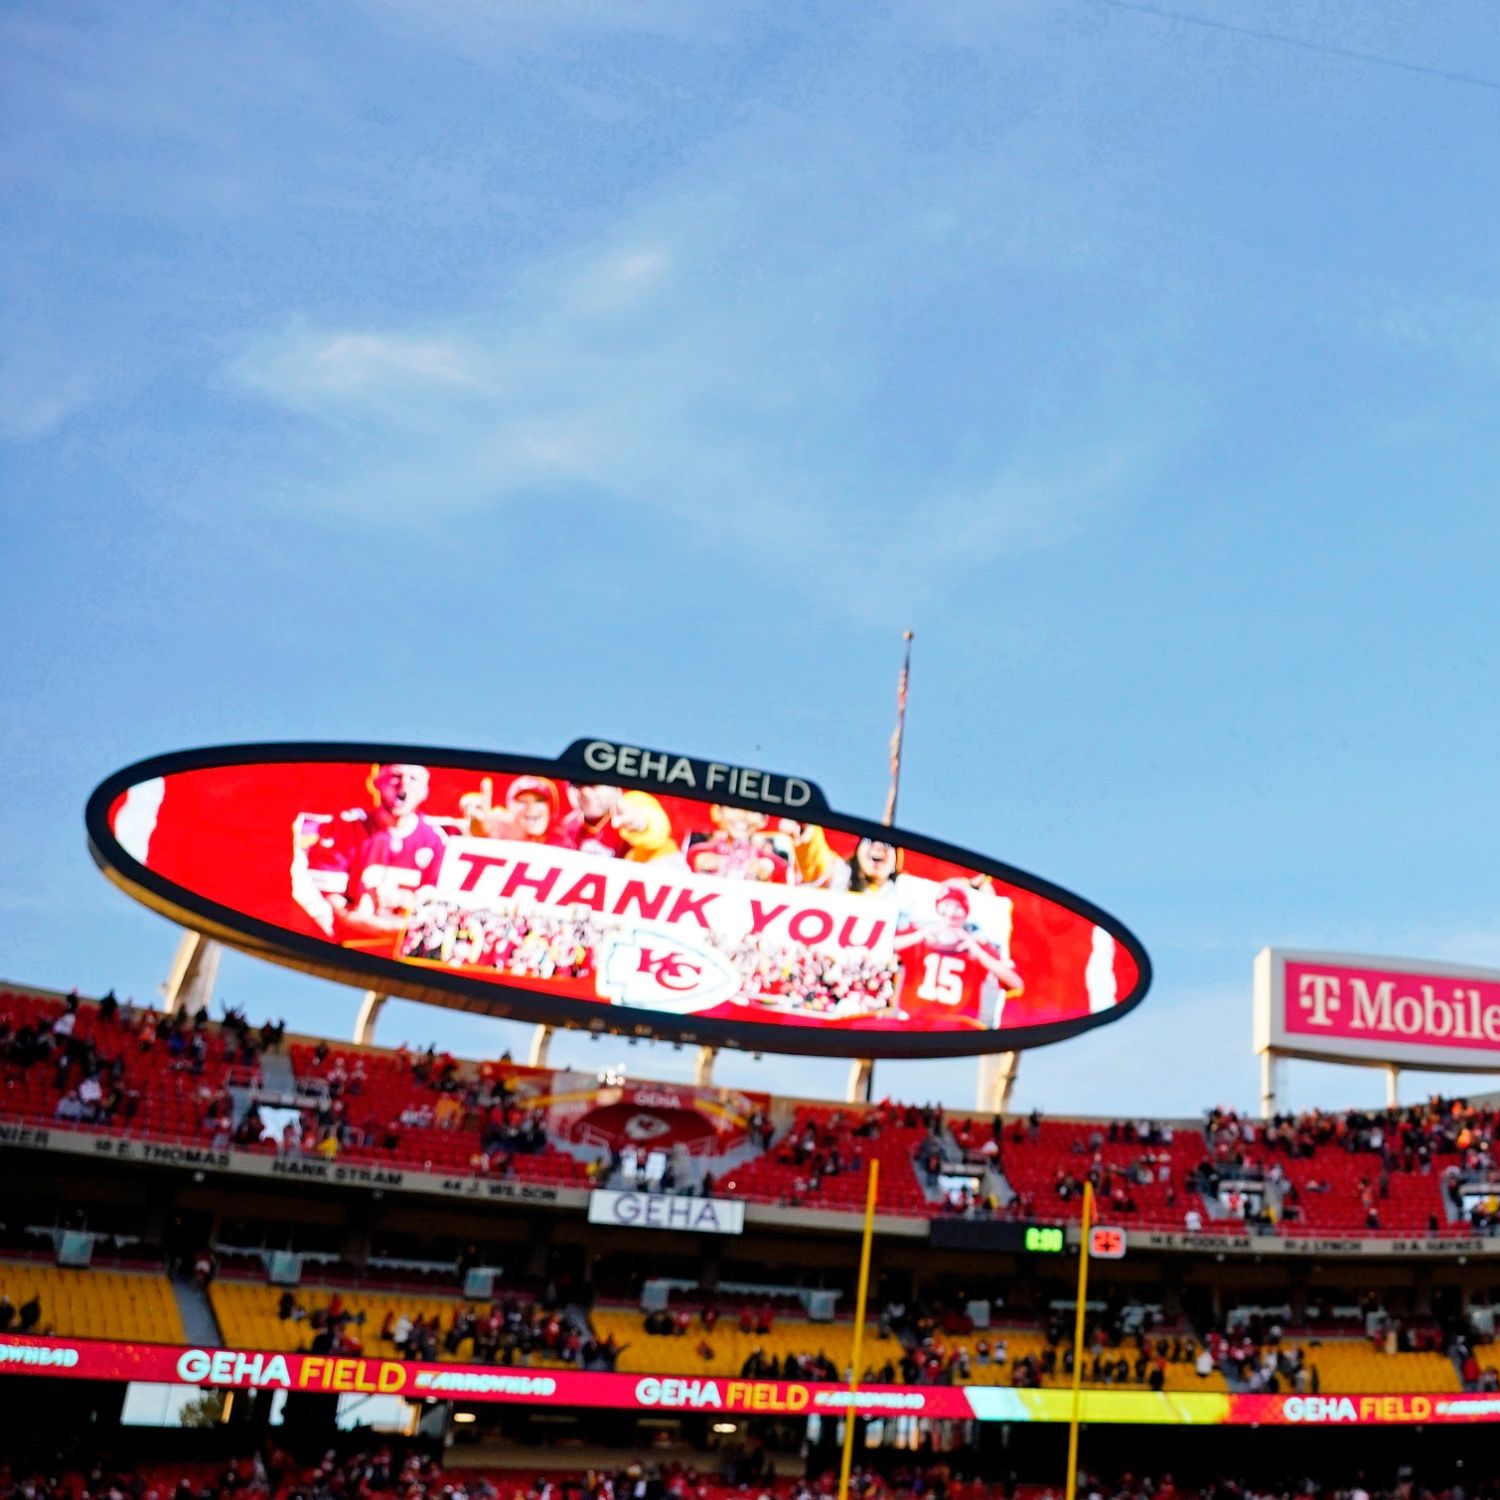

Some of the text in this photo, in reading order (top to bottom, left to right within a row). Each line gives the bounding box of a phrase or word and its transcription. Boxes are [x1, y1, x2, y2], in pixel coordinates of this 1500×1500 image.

[584, 741, 811, 807] GEHA FIELD
[458, 853, 721, 928] THANK
[750, 899, 887, 950] YOU
[636, 947, 702, 991] KC
[917, 953, 966, 1006] 15
[613, 1192, 721, 1229] GEHA
[177, 1350, 291, 1387] GEHA
[299, 1356, 407, 1393] FIELD
[635, 1378, 722, 1408] GEHA
[725, 1382, 809, 1411] FIELD
[1283, 1396, 1357, 1421] GEHA
[1360, 1396, 1432, 1421] FIELD
